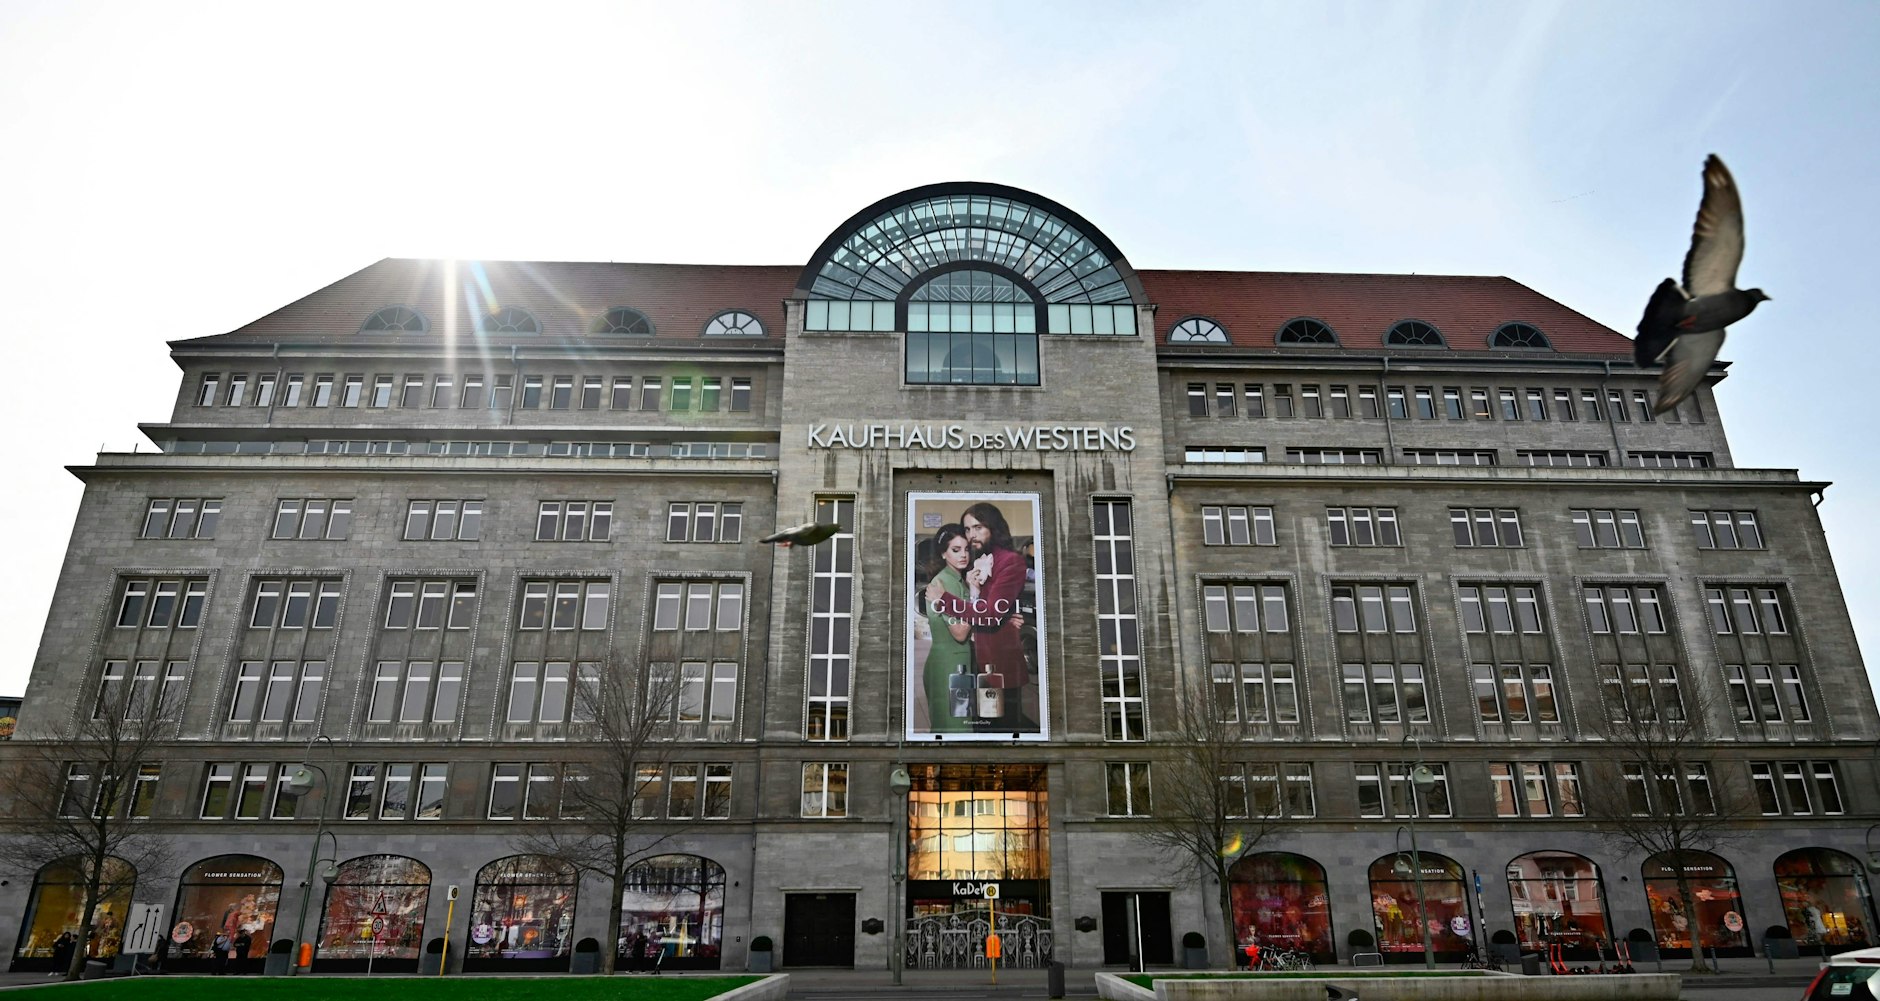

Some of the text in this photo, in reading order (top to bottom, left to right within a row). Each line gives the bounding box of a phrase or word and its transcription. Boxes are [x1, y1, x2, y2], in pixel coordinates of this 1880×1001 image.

[808, 424, 1136, 450] KAUFHAUS DES WESTENS
[930, 598, 1020, 614] GUCCI
[948, 616, 1003, 626] GUILTY
